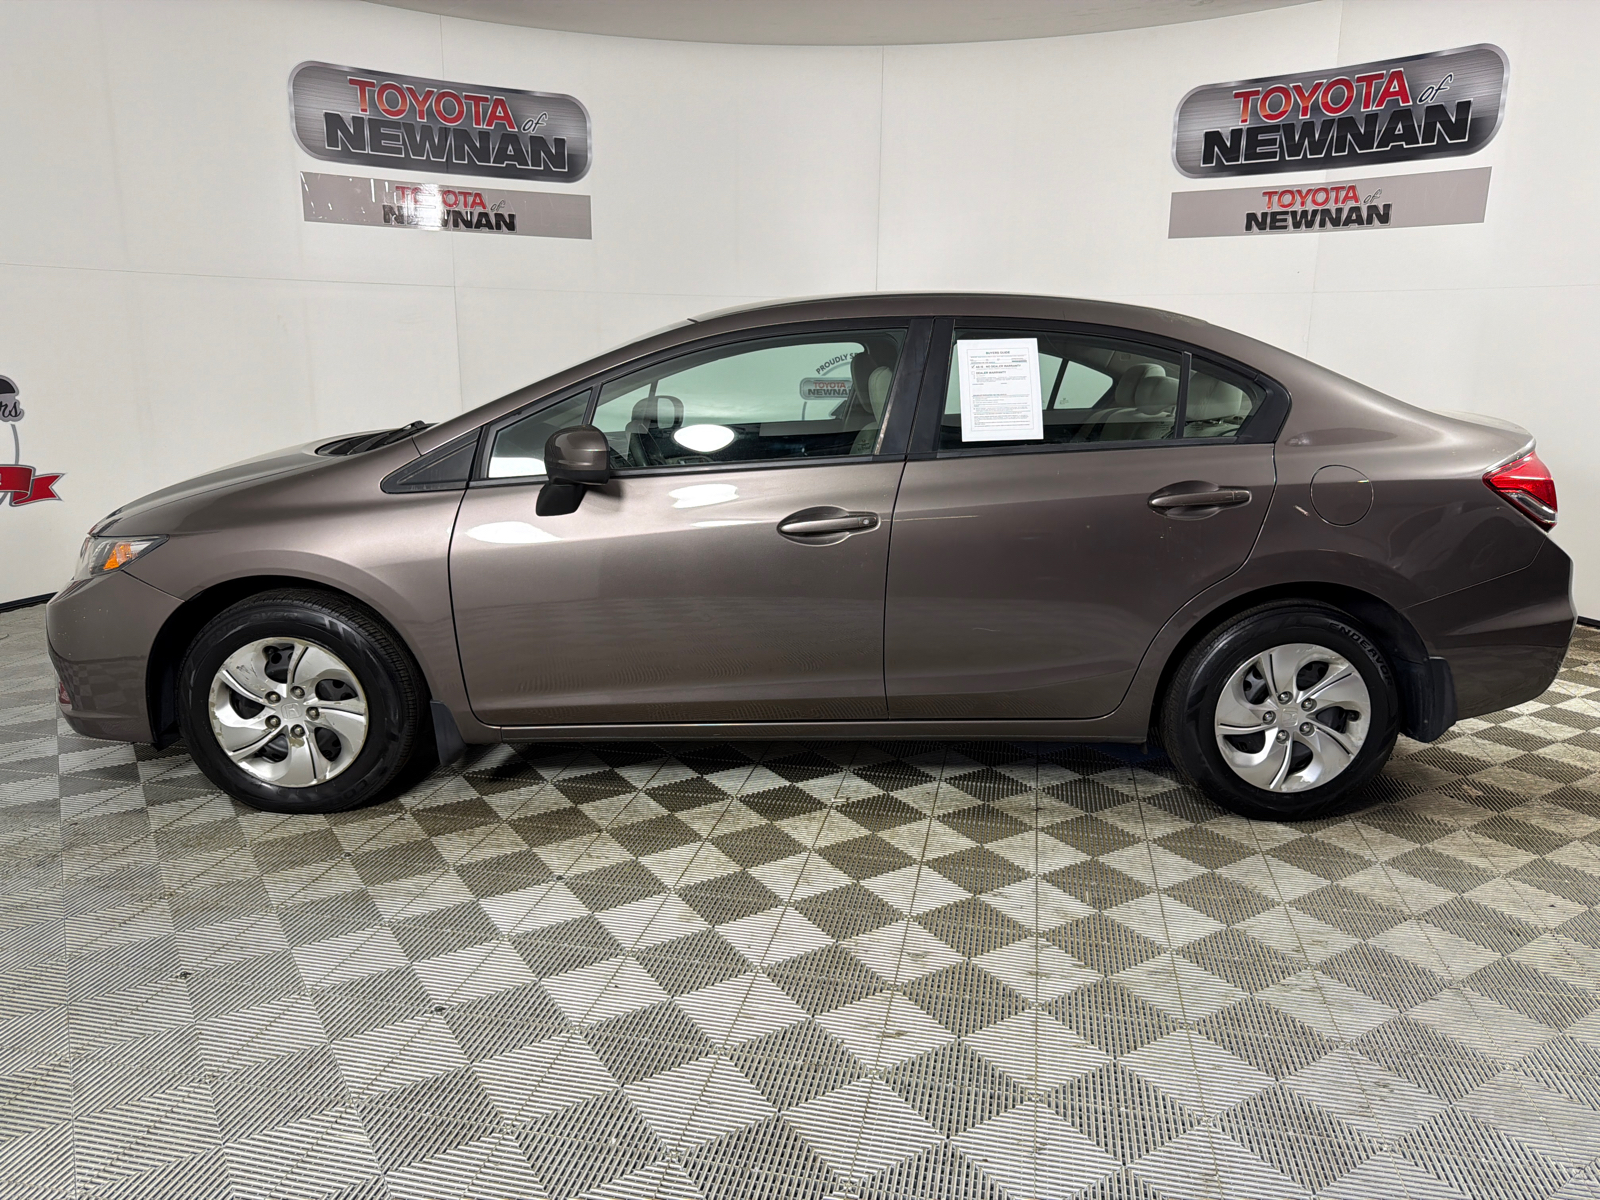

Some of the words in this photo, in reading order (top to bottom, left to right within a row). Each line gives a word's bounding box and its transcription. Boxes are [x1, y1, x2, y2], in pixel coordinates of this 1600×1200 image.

[347, 76, 519, 131] TOYOTA
[521, 112, 549, 134] of
[1233, 68, 1413, 125] TOYOTA
[1417, 73, 1454, 104] of
[323, 110, 568, 172] NEWNAN
[1200, 98, 1473, 168] NEWNAN
[395, 185, 487, 210] TOOTA
[490, 199, 506, 212] of
[1262, 184, 1361, 210] TOYOTA
[1363, 188, 1382, 205] of
[382, 204, 516, 232] NNAN
[1244, 203, 1393, 233] NEWNAN
[815, 353, 848, 375] PROUDLY
[813, 381, 846, 389] TOYOTA
[1328, 622, 1392, 687] ENDEAVOR
